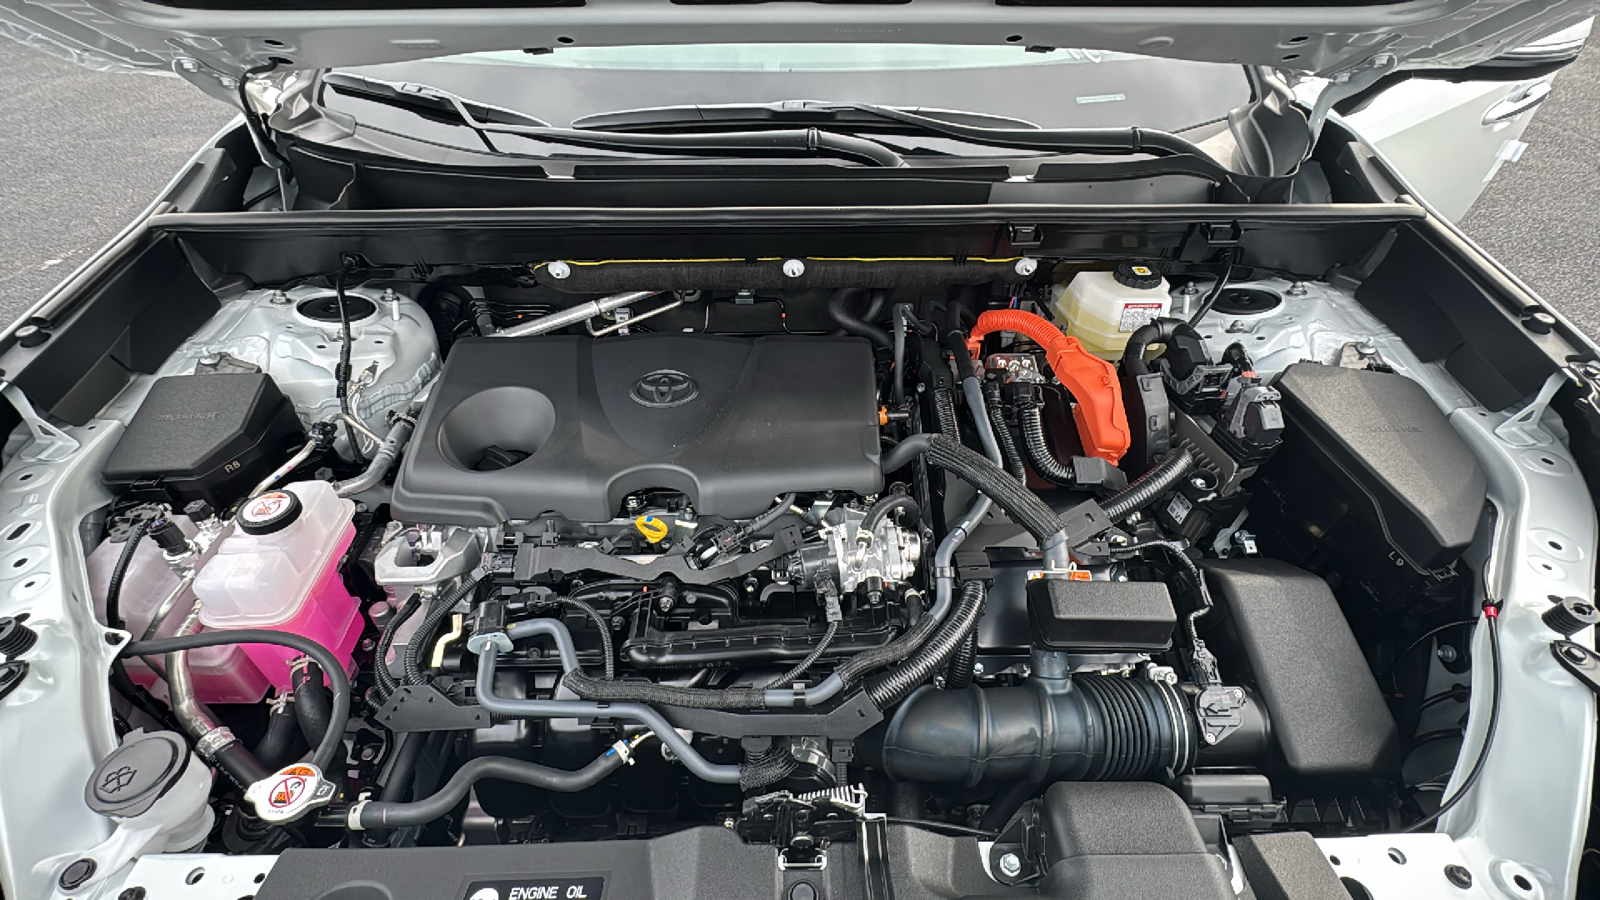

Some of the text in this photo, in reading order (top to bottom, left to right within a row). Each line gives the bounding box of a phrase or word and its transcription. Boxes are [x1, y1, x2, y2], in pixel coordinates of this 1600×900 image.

[224, 460, 241, 474] R8
[508, 885, 588, 900] ENGINE OIL
